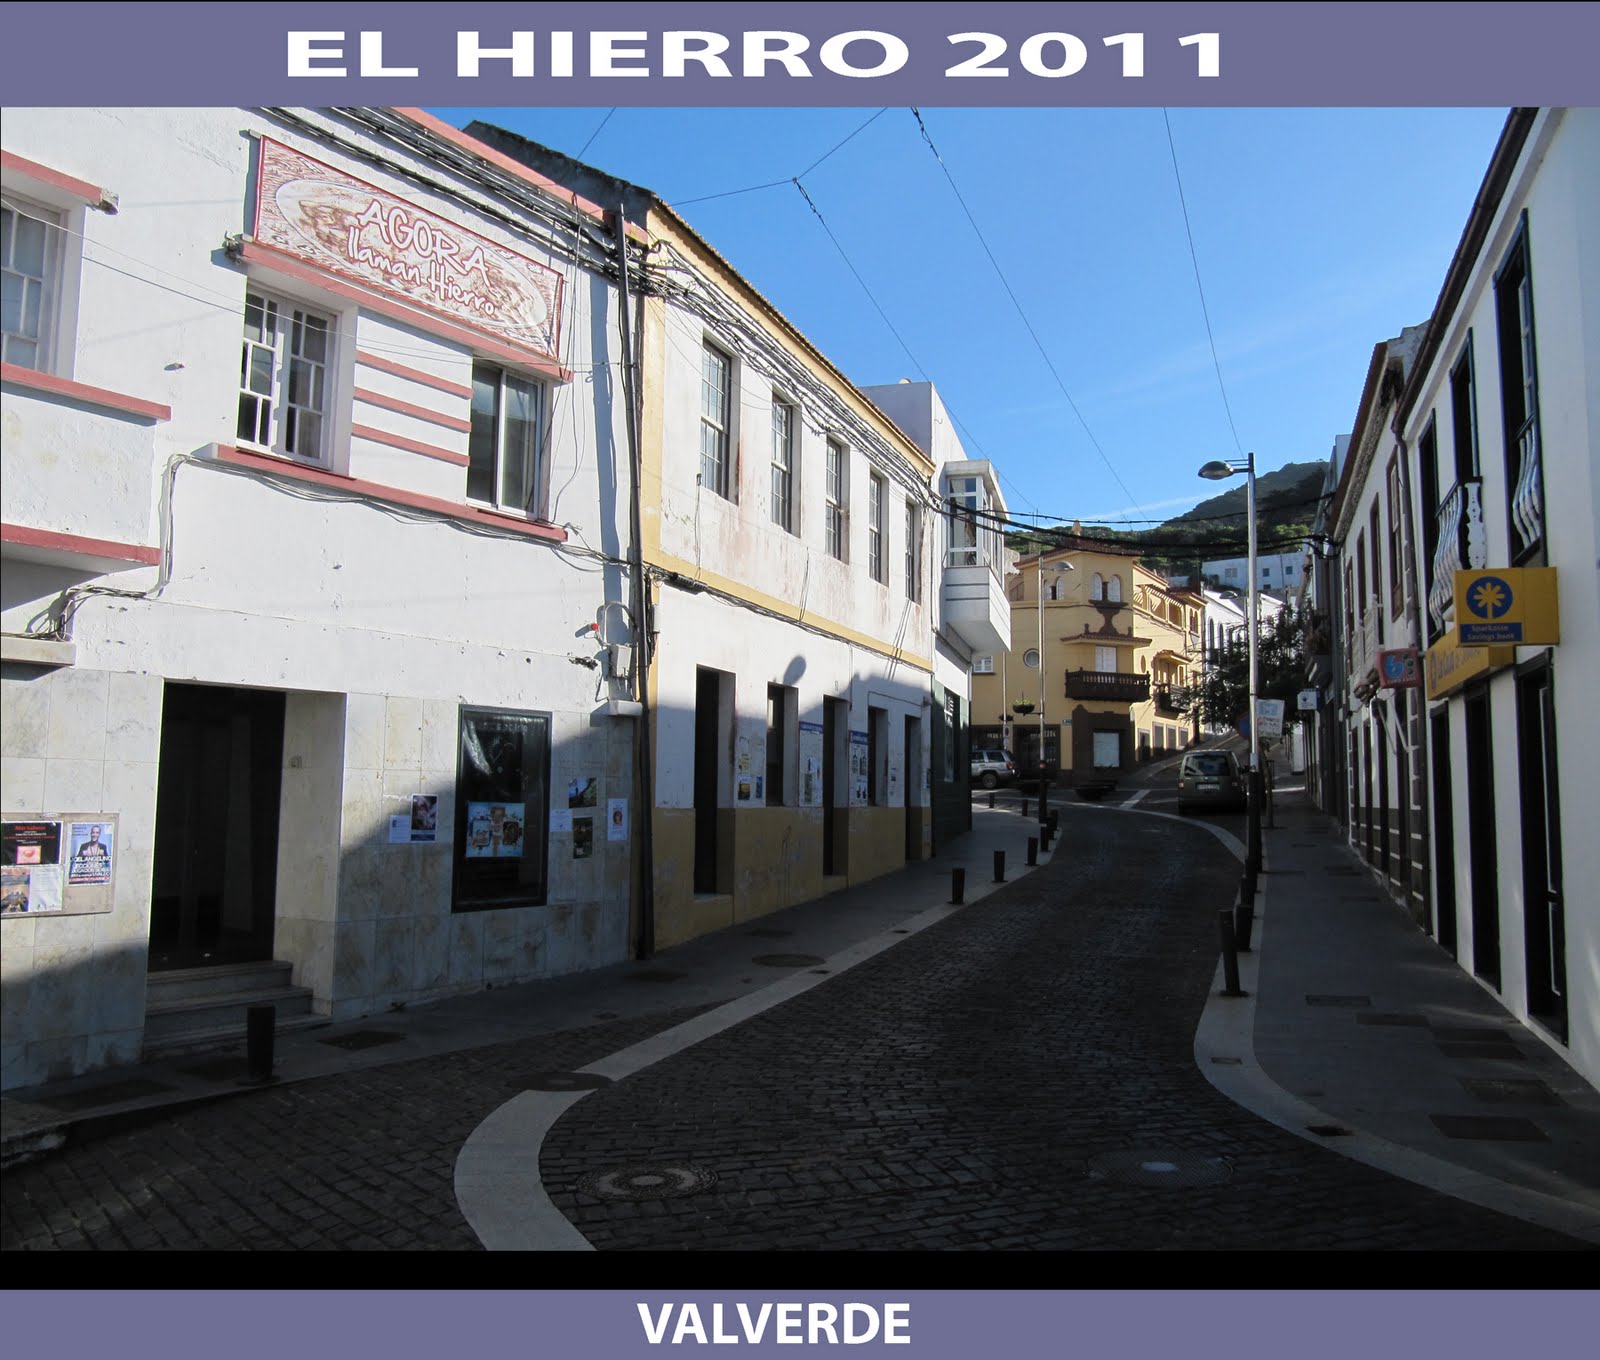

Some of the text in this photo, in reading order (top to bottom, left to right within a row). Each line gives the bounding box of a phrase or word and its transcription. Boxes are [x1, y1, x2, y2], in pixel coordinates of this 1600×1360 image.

[355, 200, 490, 287] AGORA
[428, 261, 495, 315] Hierro
[1467, 632, 1515, 641] Savings bank
